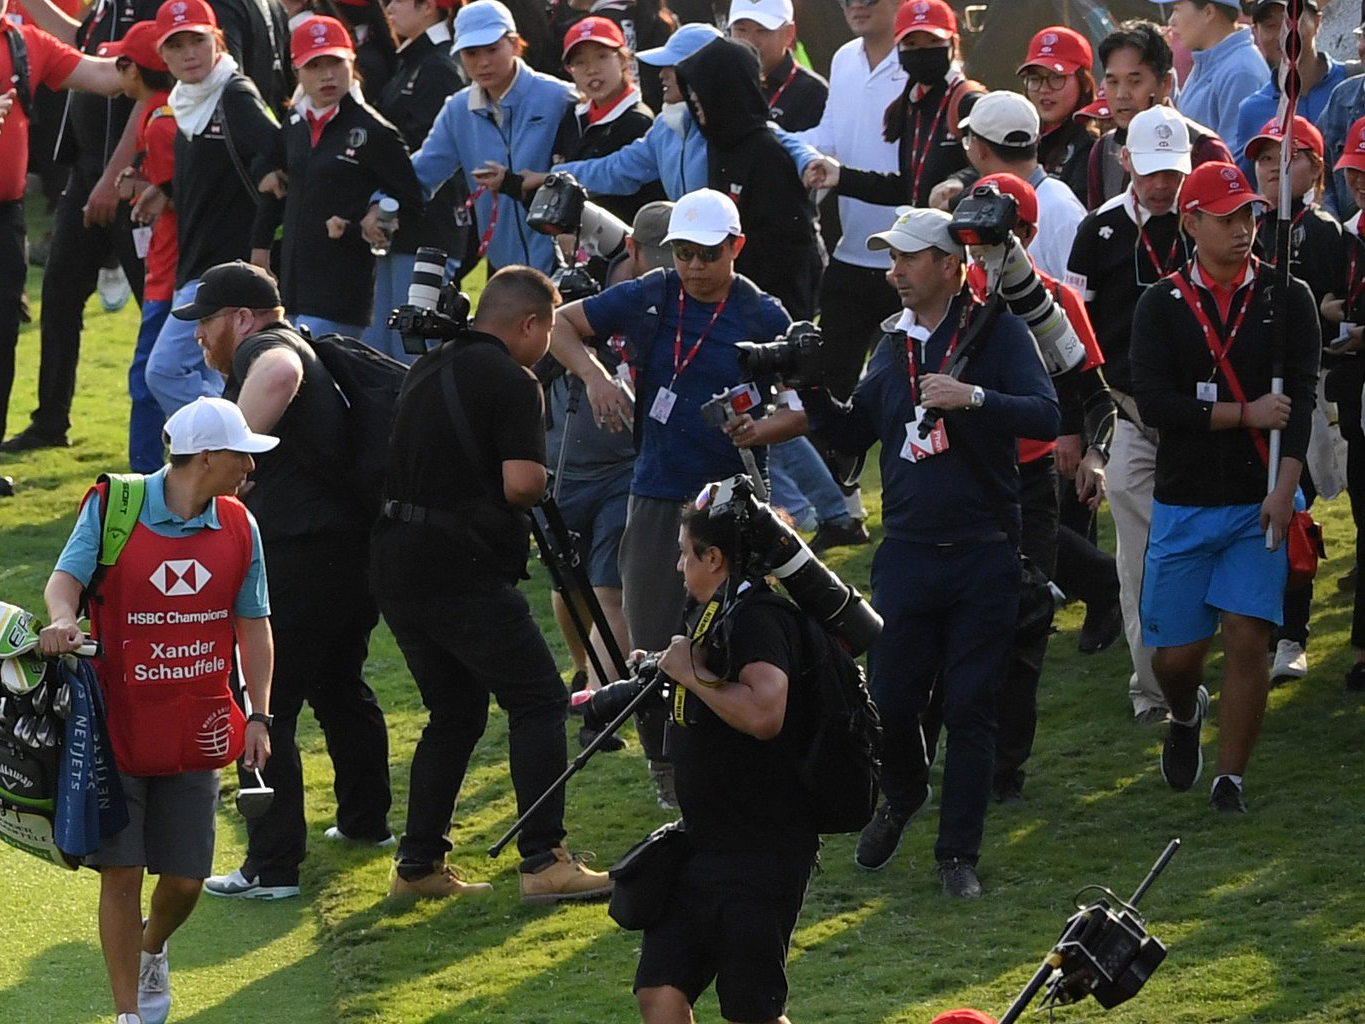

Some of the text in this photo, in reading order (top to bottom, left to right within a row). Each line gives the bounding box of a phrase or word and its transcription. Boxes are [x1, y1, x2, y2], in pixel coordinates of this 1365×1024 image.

[127, 608, 229, 626] HSBC Champions
[150, 640, 215, 660] Xander
[134, 656, 225, 681] Schauffele
[70, 715, 88, 792] NETJETS
